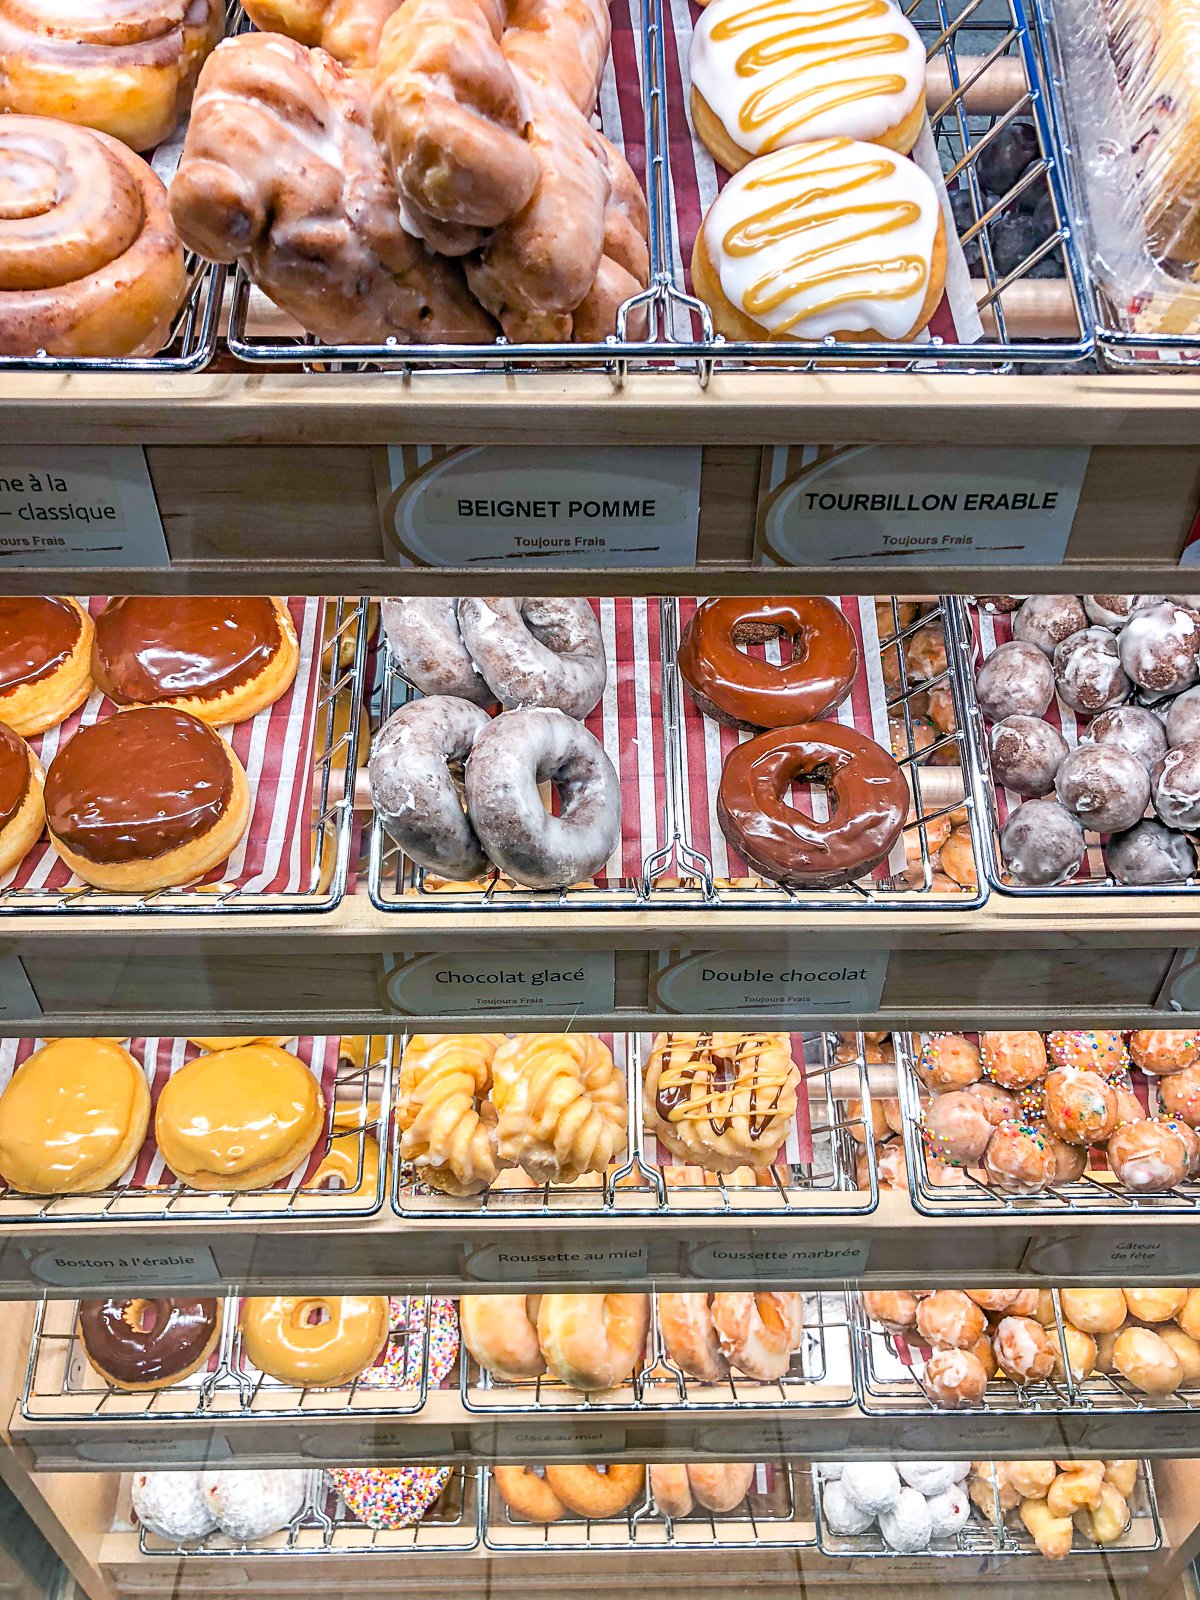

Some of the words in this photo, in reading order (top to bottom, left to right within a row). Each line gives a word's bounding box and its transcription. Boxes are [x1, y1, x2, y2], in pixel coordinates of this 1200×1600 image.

[29, 473, 43, 492] à
[47, 473, 68, 492] la
[805, 493, 958, 511] TOURBILLON
[963, 492, 1058, 510] ERABLE
[18, 503, 117, 523] classique
[457, 499, 562, 518] BEIGNET
[568, 499, 656, 517] POMME
[0, 537, 30, 548] ours
[32, 536, 66, 546] Frais
[514, 536, 571, 549] Toujours
[574, 536, 606, 546] Frais
[881, 535, 938, 547] Toujours
[941, 534, 974, 545] Frais
[435, 970, 526, 984] Chocolat
[531, 967, 585, 986] glacé
[702, 969, 774, 982] Double
[779, 967, 868, 982] chocolat
[475, 997, 518, 1005] Toujours
[743, 996, 785, 1004] Toujours
[787, 995, 811, 1003] Frais
[792, 1247, 861, 1258] marbrée
[1116, 1242, 1161, 1250] Gâteau
[55, 1258, 114, 1268] Boston
[119, 1257, 129, 1267] à
[132, 1255, 195, 1267] l'érable
[498, 1253, 580, 1262] Roussette
[584, 1252, 604, 1260] au
[608, 1249, 642, 1259] miel
[575, 1432, 603, 1440] miel
